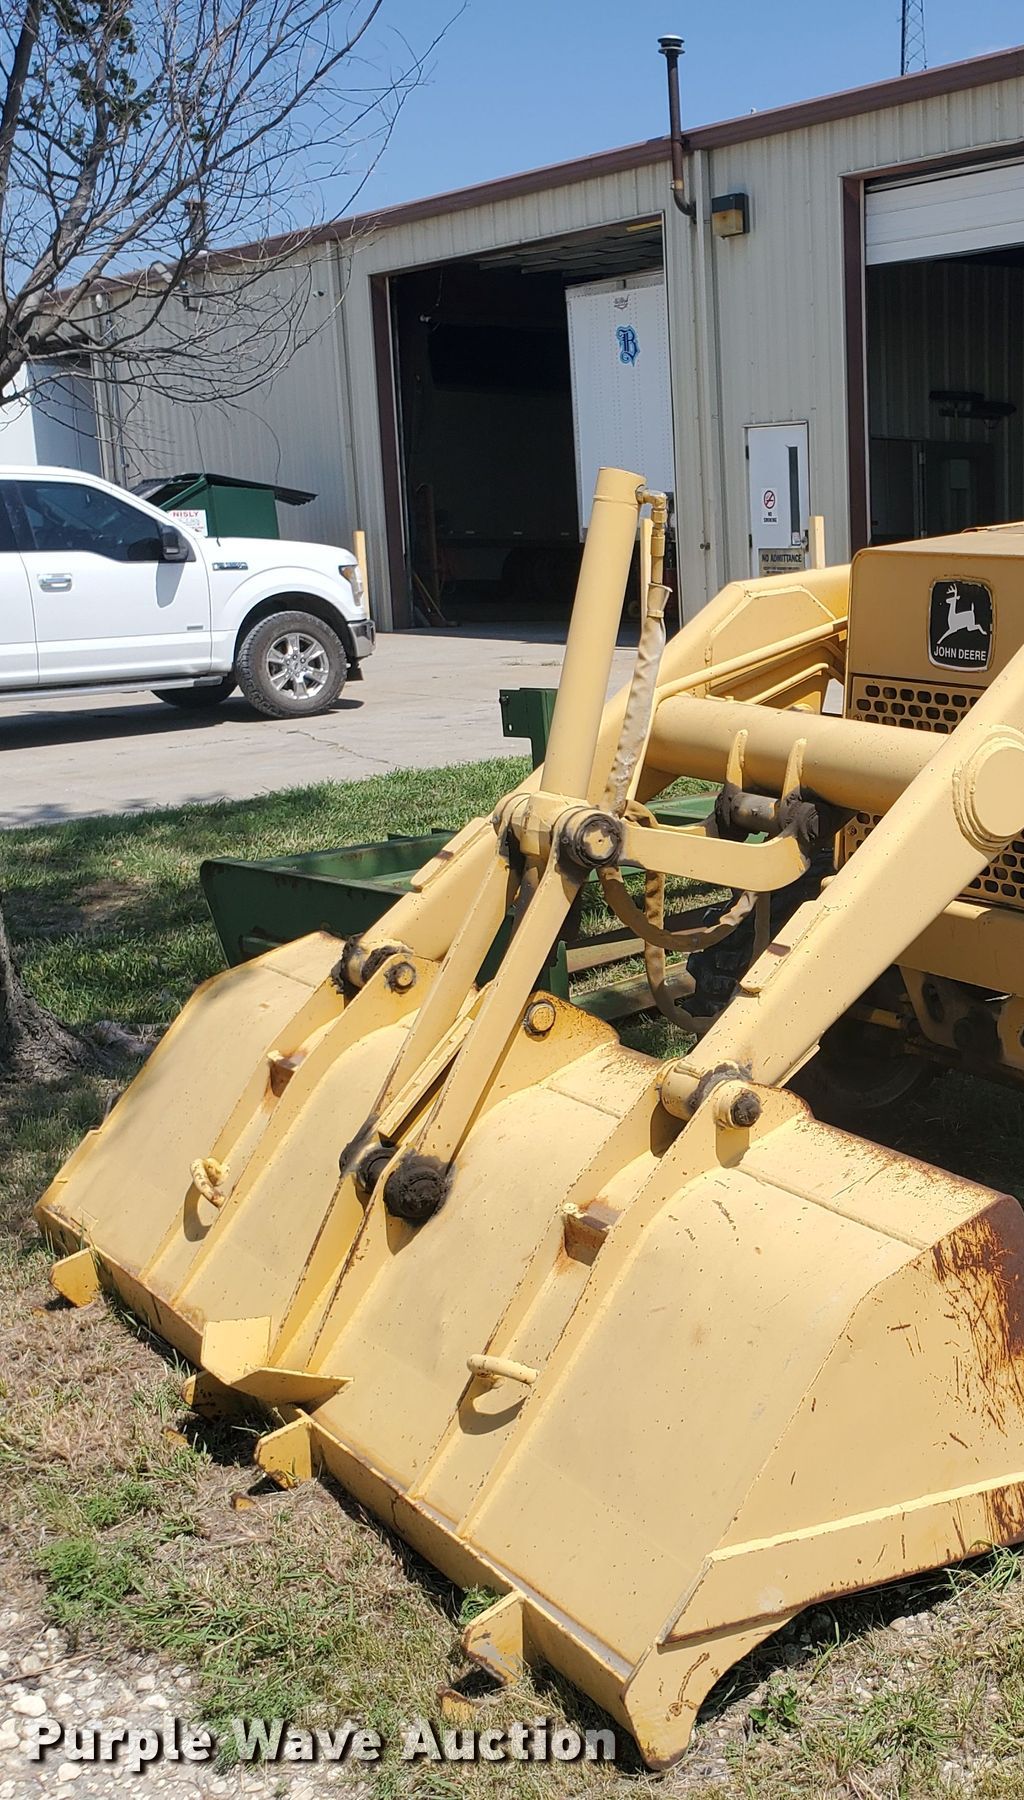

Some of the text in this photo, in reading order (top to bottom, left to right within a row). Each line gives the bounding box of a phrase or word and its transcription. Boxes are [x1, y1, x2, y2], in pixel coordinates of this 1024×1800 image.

[762, 553, 802, 563] NO ADMITTANCE
[934, 646, 987, 661] JOHN DEERE
